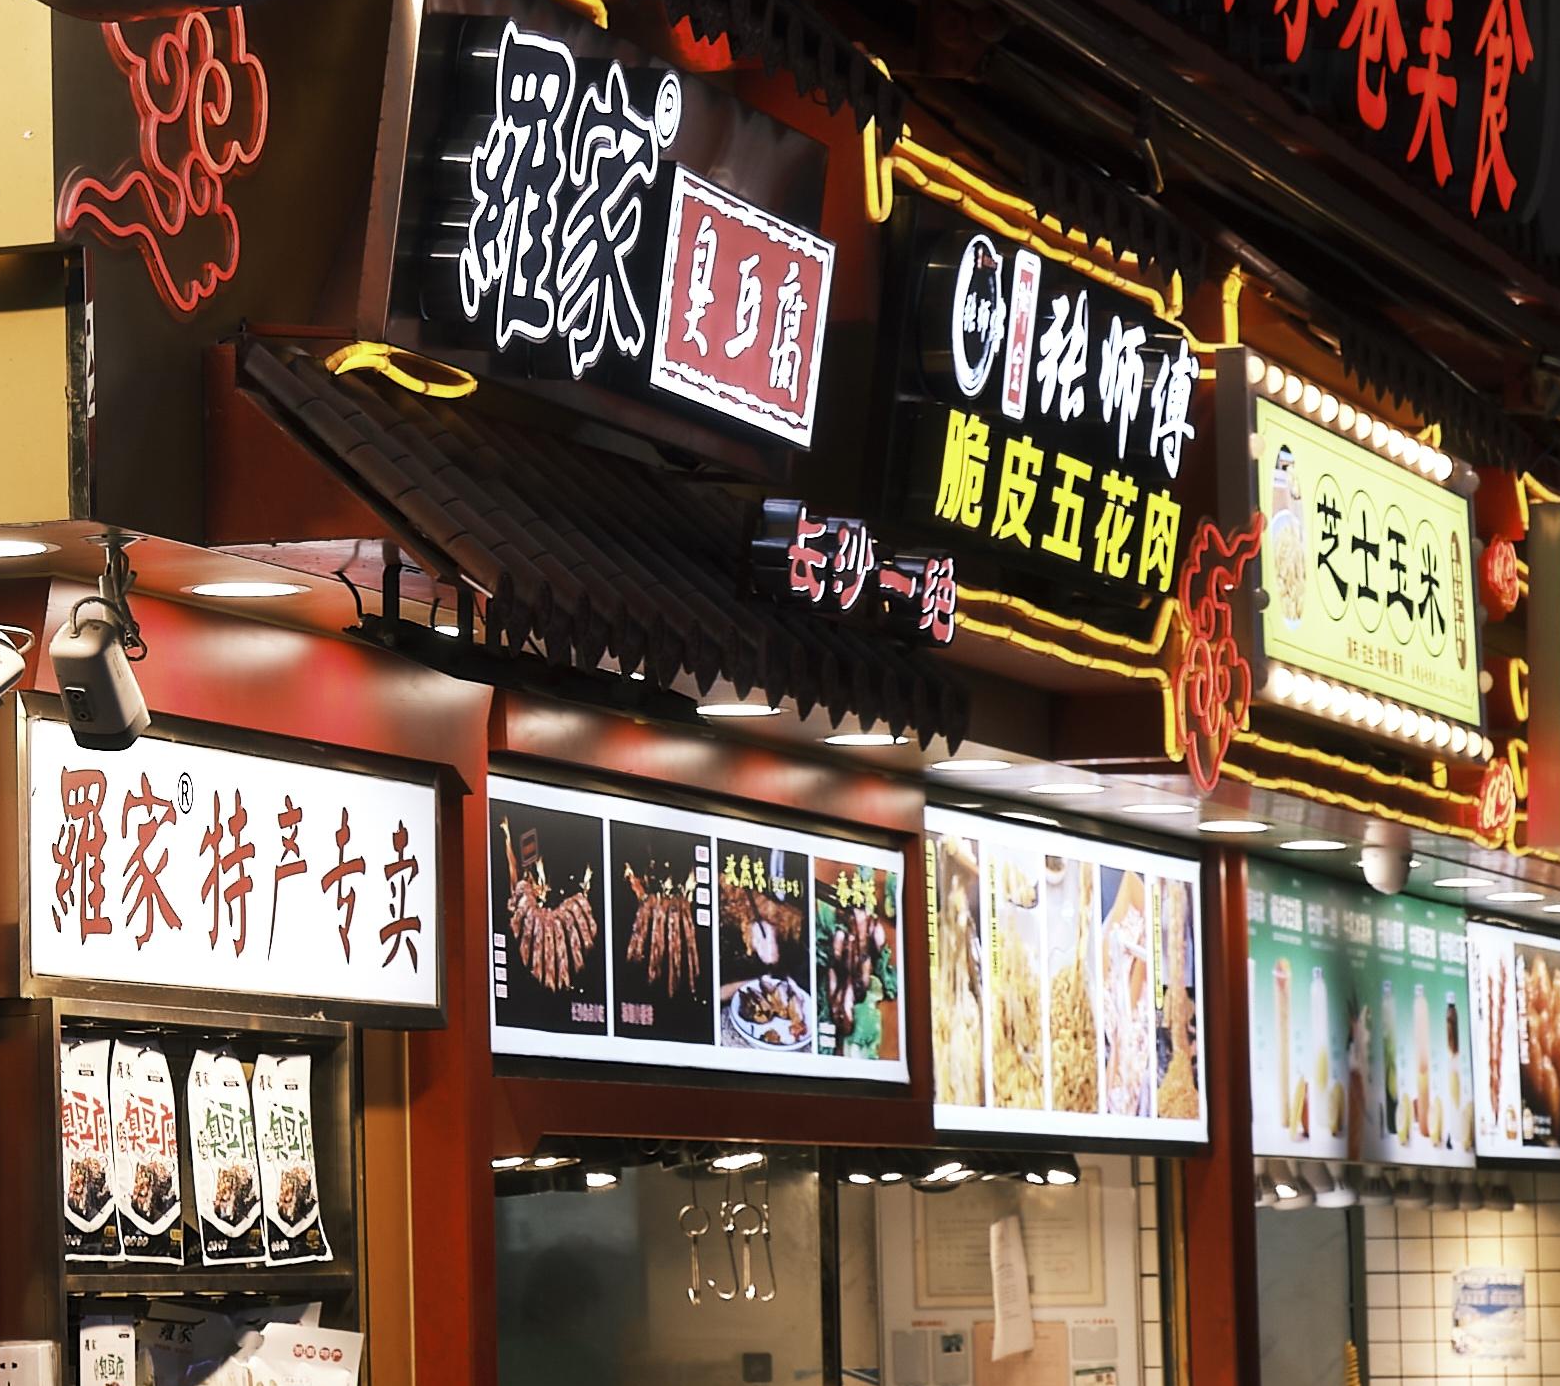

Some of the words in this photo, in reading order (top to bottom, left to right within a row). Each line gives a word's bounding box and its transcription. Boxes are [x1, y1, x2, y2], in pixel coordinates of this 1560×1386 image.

[459, 19, 658, 381] 羅家
[682, 213, 808, 403] 臭豆腐
[1036, 289, 1201, 480] 张师傅
[787, 506, 957, 644] 长沙一绝
[934, 409, 1182, 593] 脆皮五花肉
[1316, 493, 1446, 639] 芝士玉米
